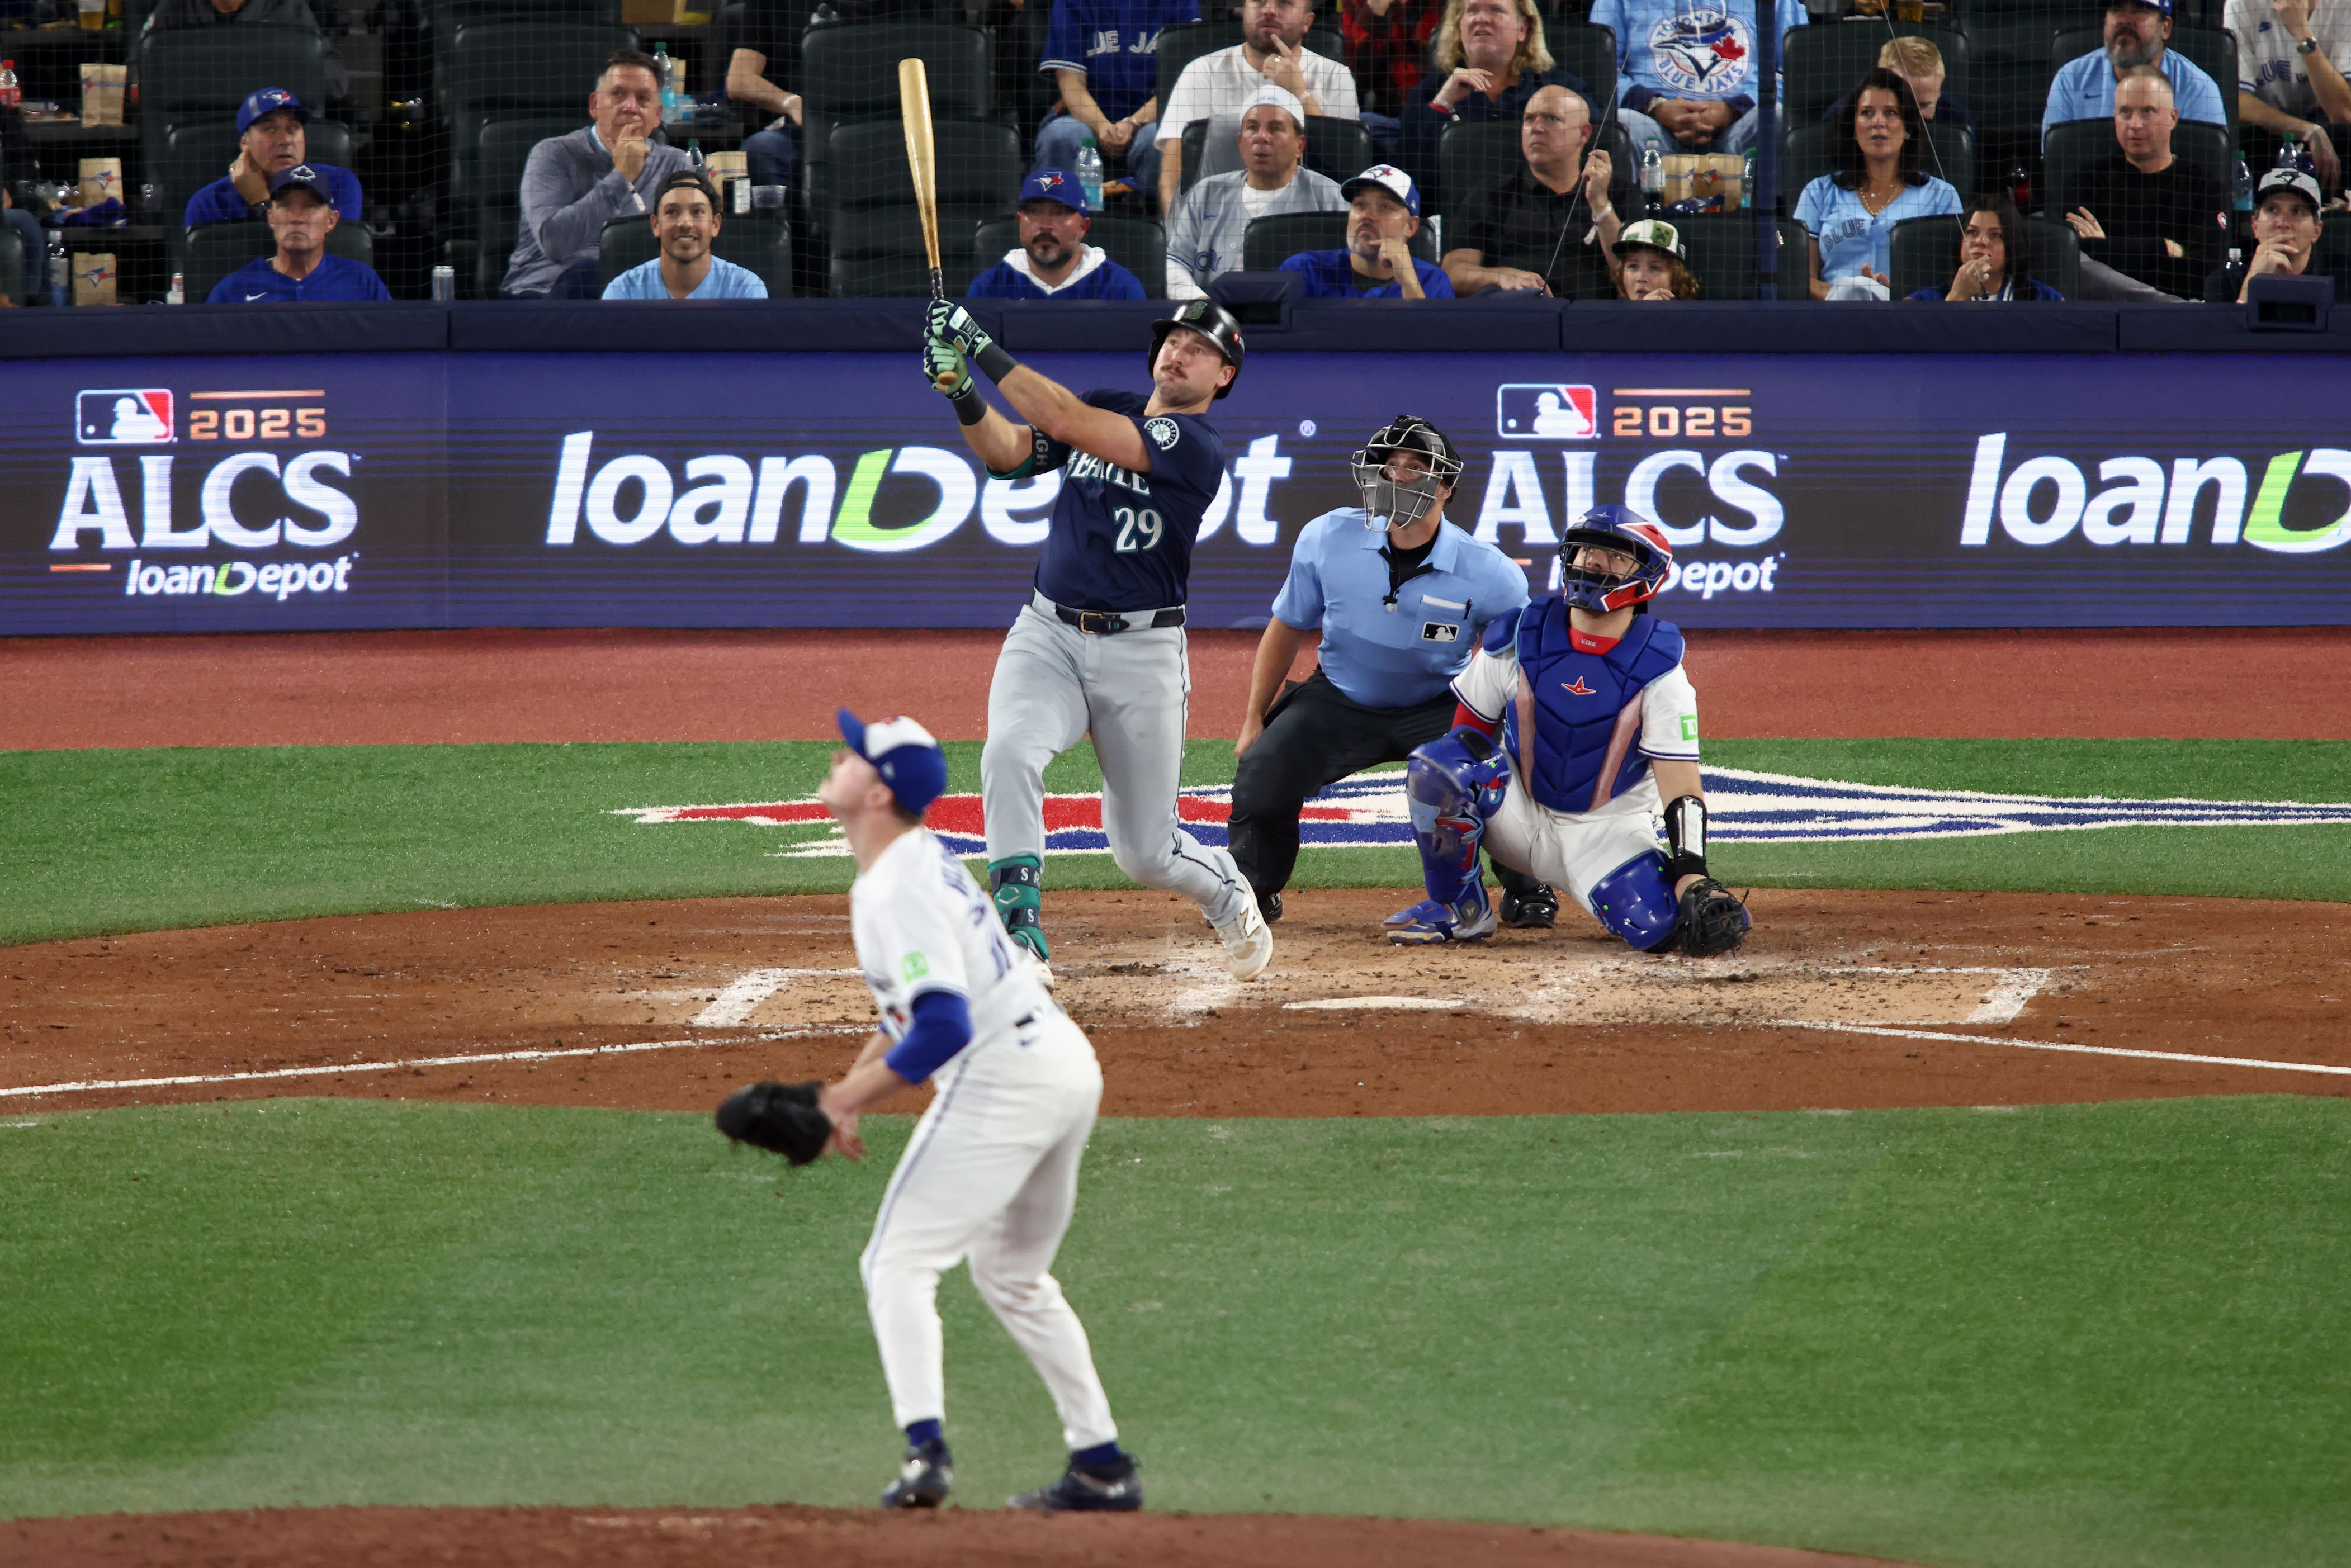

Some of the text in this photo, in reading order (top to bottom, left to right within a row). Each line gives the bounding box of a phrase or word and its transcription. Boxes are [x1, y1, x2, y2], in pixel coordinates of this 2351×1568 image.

[1659, 59, 1743, 92] BLUE JAYS
[1823, 217, 1866, 250] BLUE
[190, 409, 326, 439] 2025
[1613, 407, 1751, 437] 2025
[49, 451, 358, 549] ALCS
[546, 431, 1292, 552] loanDet
[1473, 449, 1785, 546] ALCS
[1114, 505, 1163, 553] 29
[125, 555, 352, 601] loanDepot
[1683, 719, 1698, 735] TD
